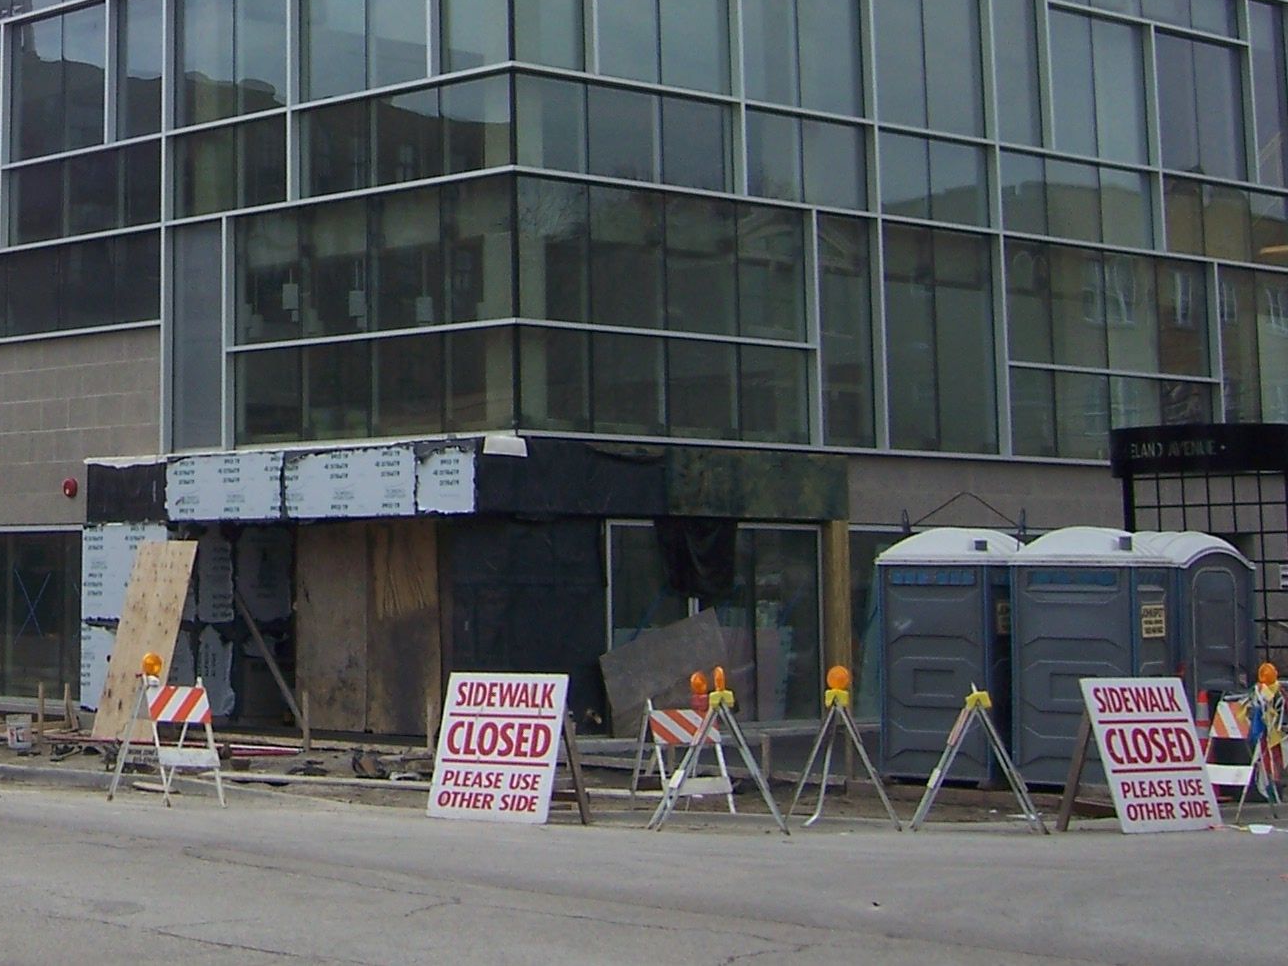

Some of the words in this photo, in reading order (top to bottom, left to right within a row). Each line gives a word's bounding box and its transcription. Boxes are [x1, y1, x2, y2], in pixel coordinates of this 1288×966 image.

[456, 681, 556, 709] SIDEWALK
[1093, 686, 1181, 713] SIDEWALK
[447, 721, 552, 758] CLOSED
[1105, 727, 1195, 764] CLOSED
[442, 770, 504, 789] PLEASE
[509, 773, 541, 791] USE
[1121, 780, 1175, 798] PLEASE
[1178, 779, 1205, 796] USE
[437, 790, 494, 810] OTHER
[499, 794, 538, 812] SIDE
[1127, 802, 1176, 821] OTHER
[1179, 800, 1212, 818] SIDE
